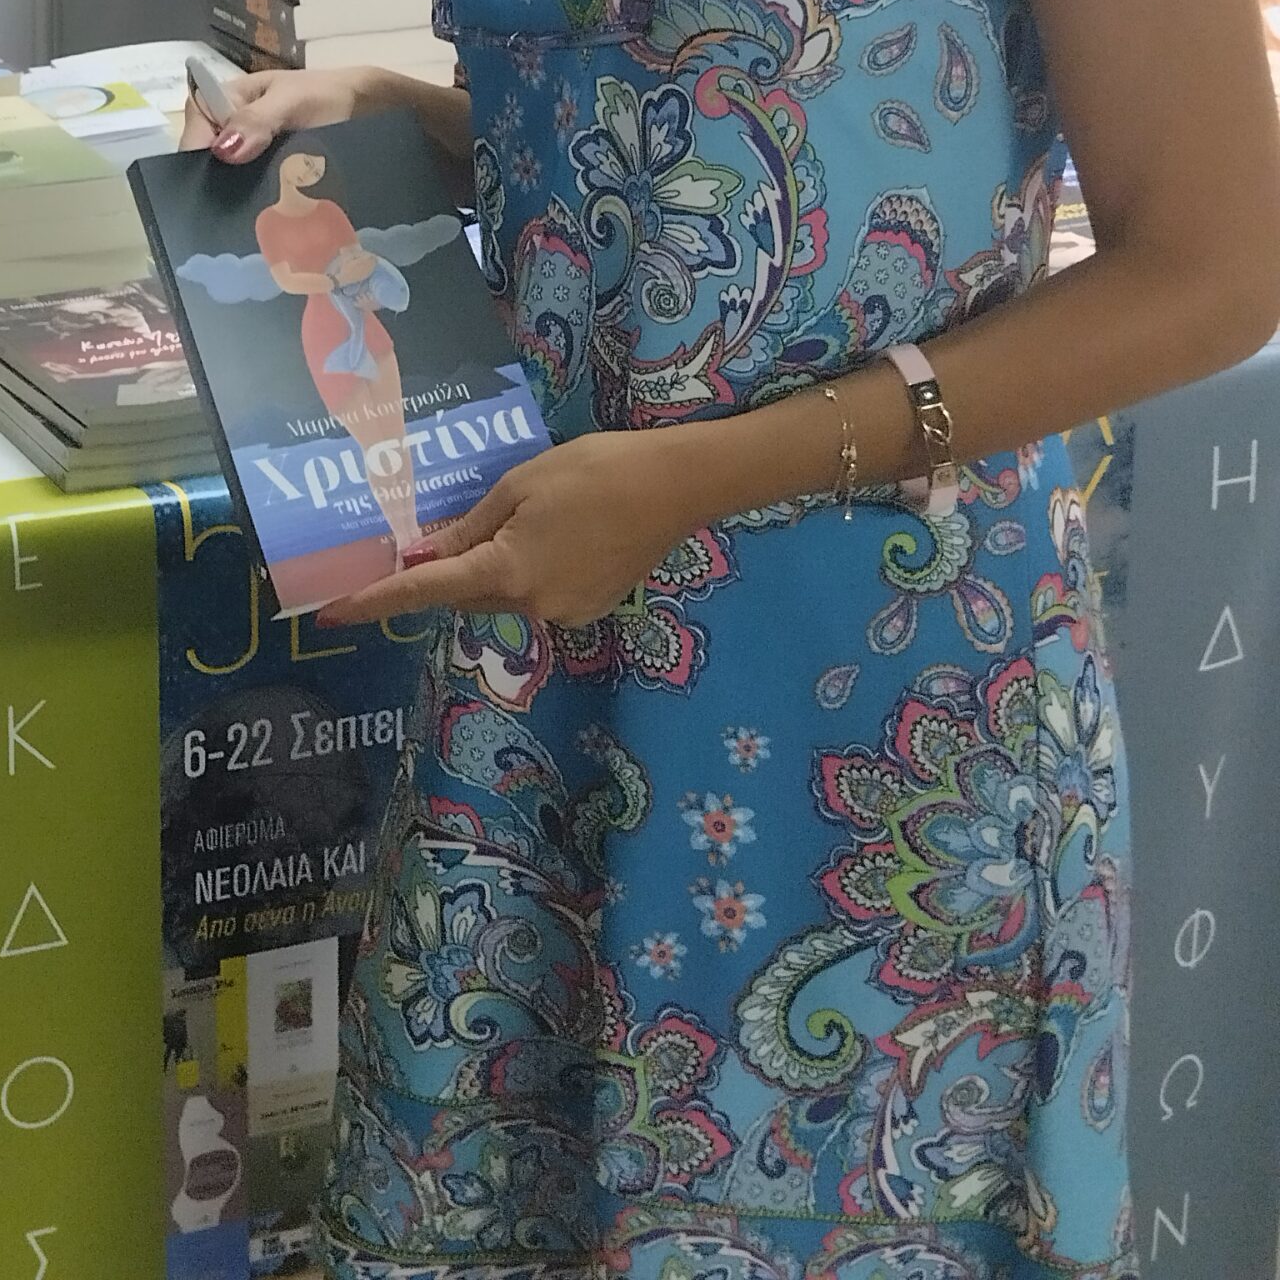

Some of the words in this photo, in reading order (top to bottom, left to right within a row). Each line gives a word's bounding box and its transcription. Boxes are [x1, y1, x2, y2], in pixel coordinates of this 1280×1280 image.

[251, 405, 537, 509] Χριστίνα
[333, 494, 372, 516] της
[184, 717, 273, 779] 6-22
[195, 852, 313, 905] ΝΕΟΛΑΙΑ
[323, 840, 366, 881] ΚΑΙ
